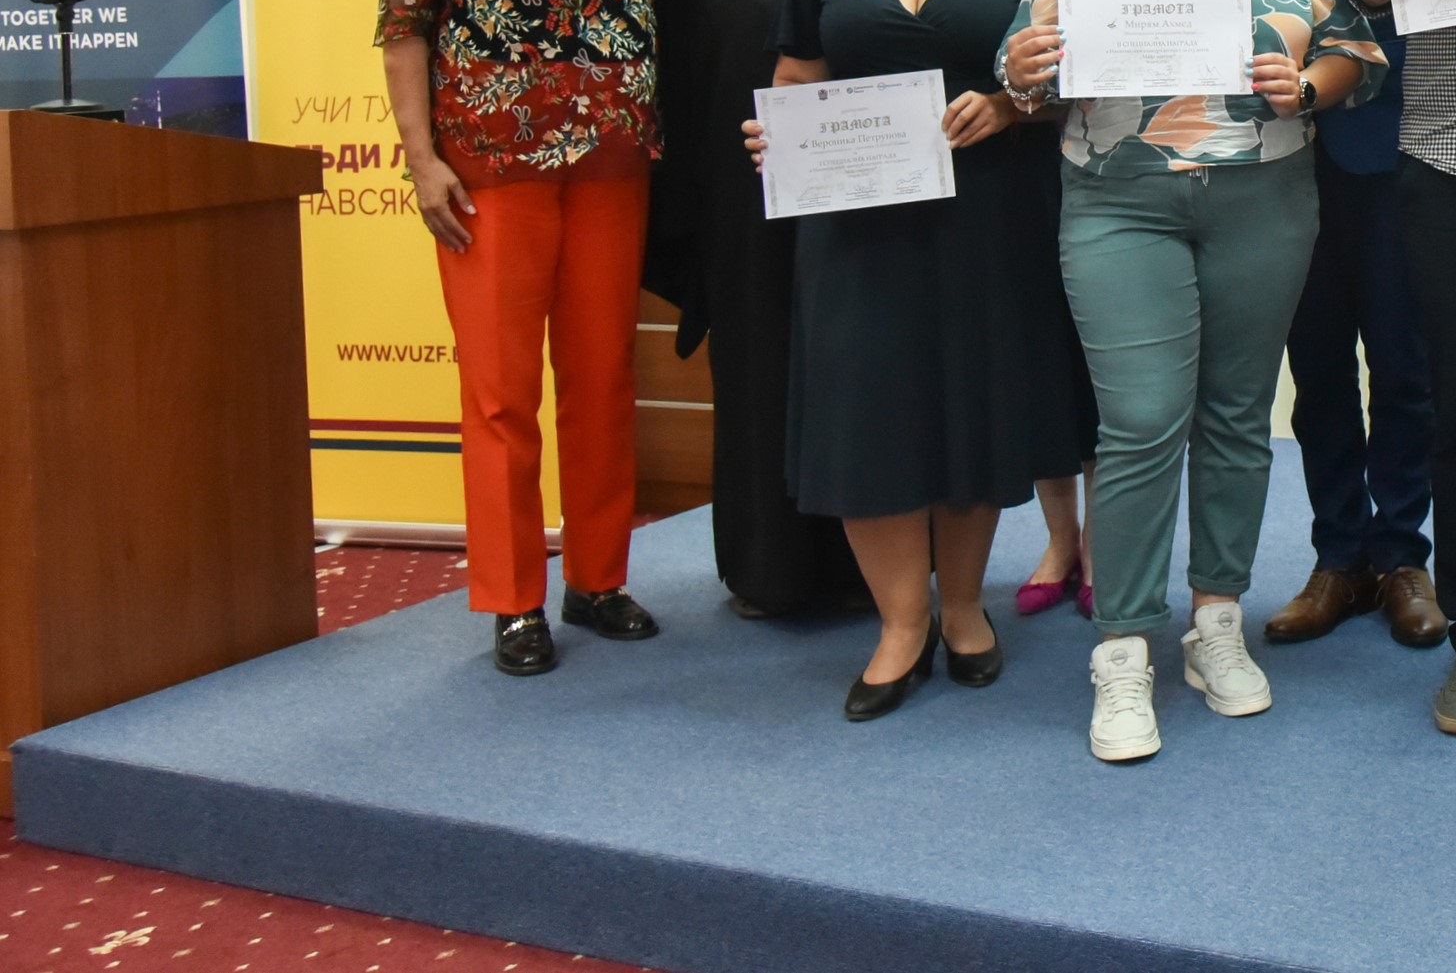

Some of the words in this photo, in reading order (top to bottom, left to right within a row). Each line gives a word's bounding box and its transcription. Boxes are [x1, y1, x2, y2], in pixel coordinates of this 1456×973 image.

[1, 8, 93, 26] TOGETER
[98, 7, 128, 23] WE
[1121, 3, 1195, 16] ГРАМОТА
[48, 34, 62, 50] IT
[70, 32, 138, 49] HAPPEN
[292, 96, 351, 124] УЧИ
[363, 95, 393, 123] ТУ
[819, 115, 891, 134] ГРАМОТА
[295, 143, 381, 173] ЪДИ
[299, 188, 418, 216] НАВСЯК
